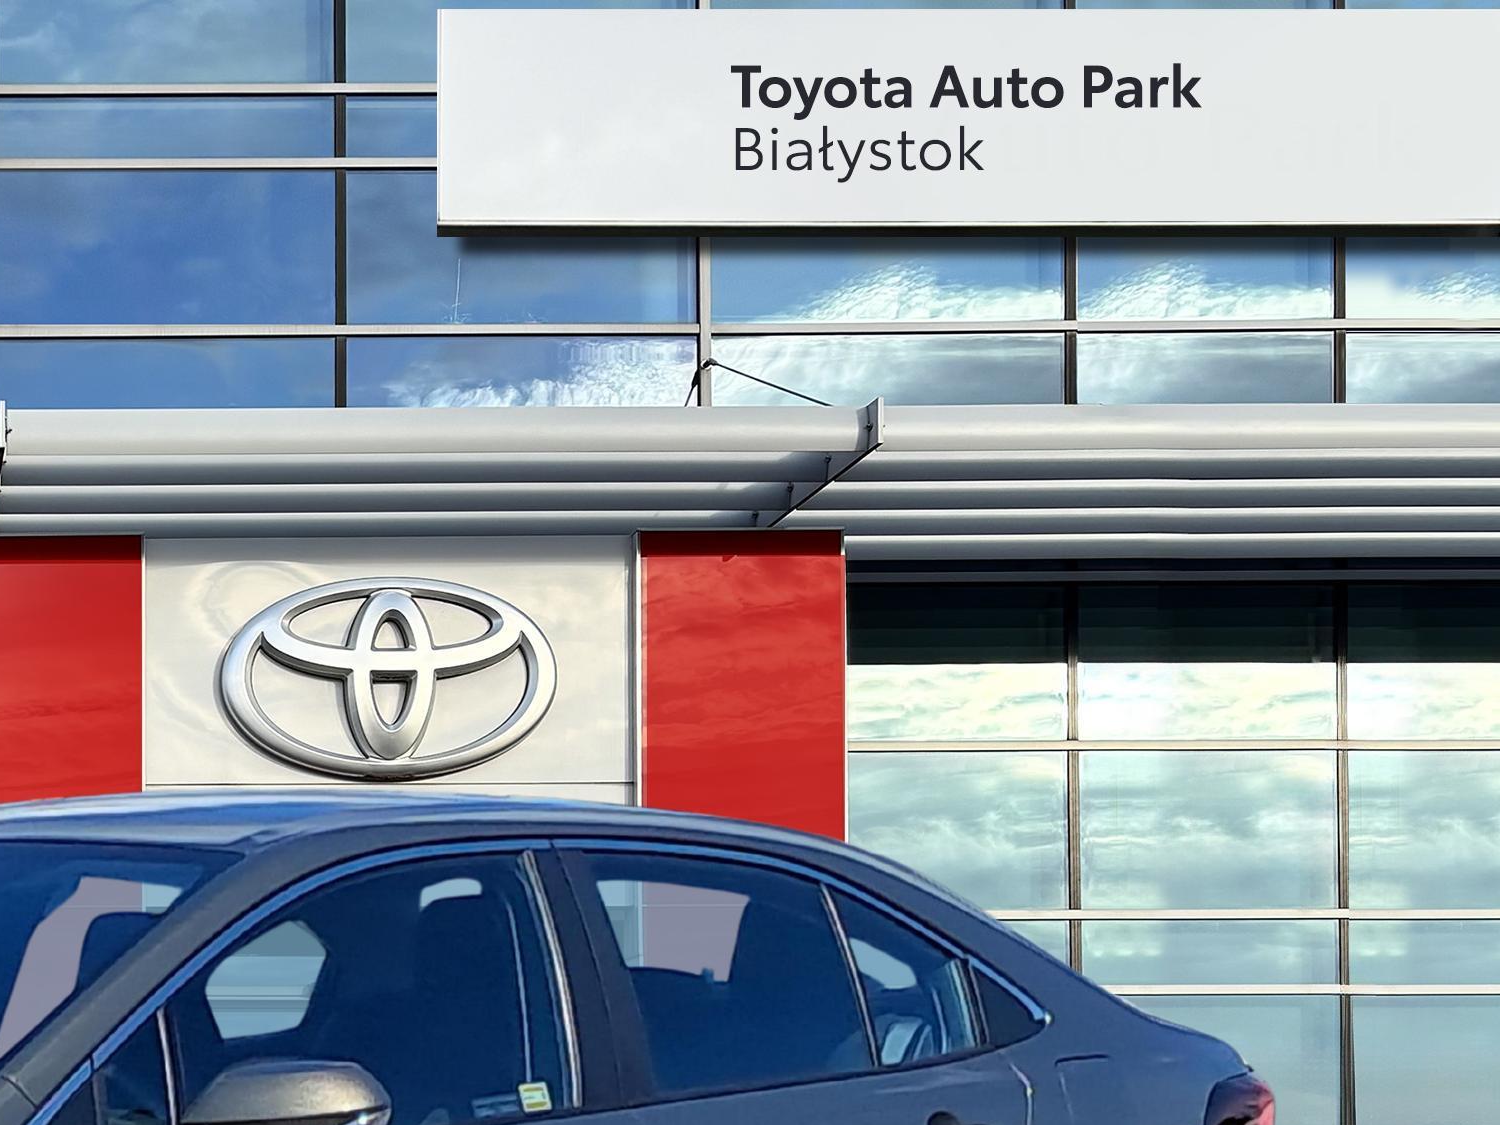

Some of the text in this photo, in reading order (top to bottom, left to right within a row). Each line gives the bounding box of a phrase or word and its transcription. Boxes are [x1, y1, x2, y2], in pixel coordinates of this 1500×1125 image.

[730, 62, 1202, 120] Toyota Auto Park
[734, 125, 986, 184] Białystok
